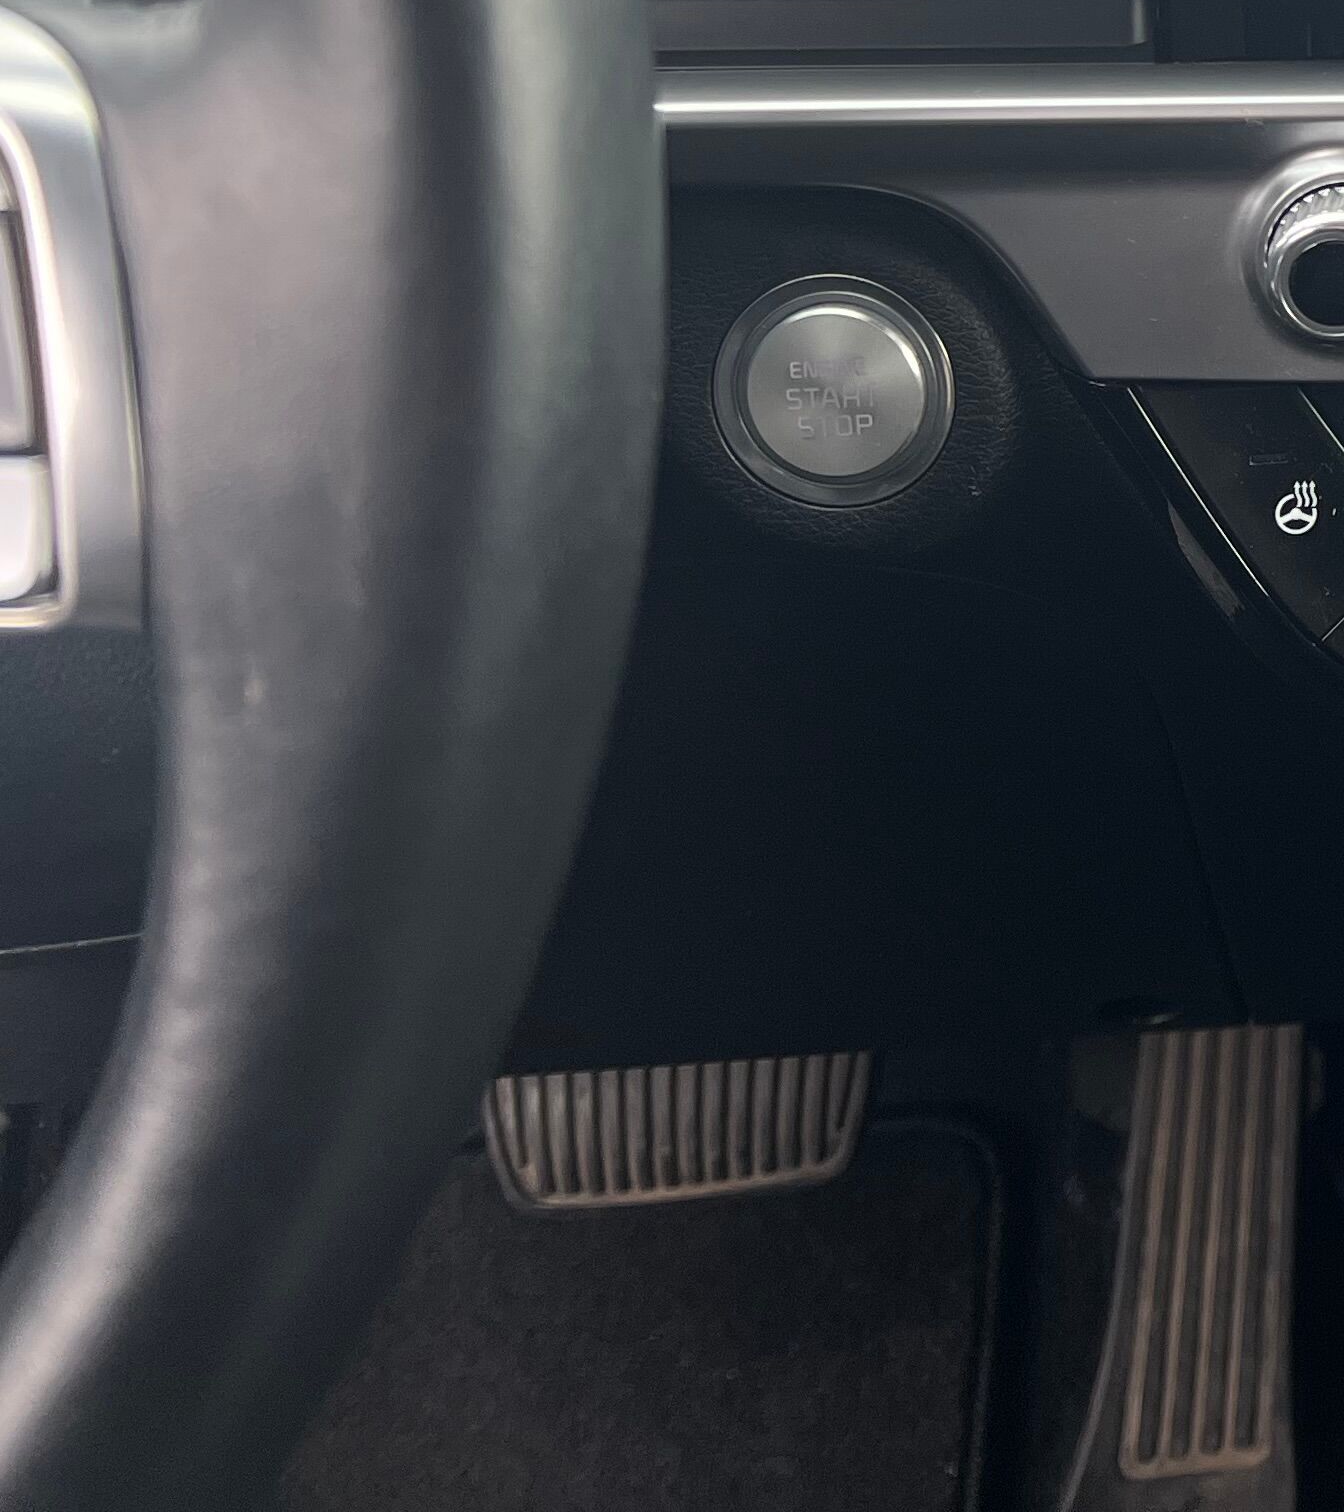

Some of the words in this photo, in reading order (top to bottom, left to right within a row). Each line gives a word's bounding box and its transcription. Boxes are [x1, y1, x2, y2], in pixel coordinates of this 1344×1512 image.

[789, 357, 865, 379] ENNE
[786, 383, 876, 410] START
[798, 413, 873, 439] STOP
